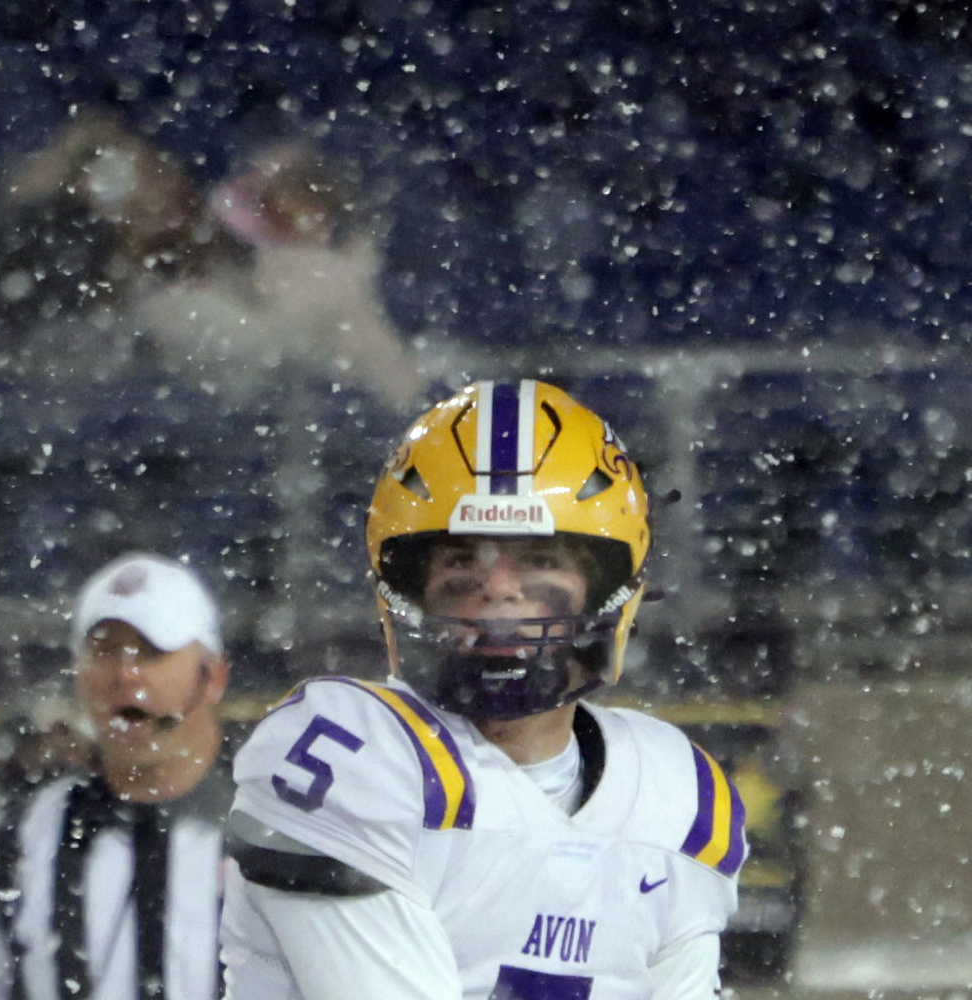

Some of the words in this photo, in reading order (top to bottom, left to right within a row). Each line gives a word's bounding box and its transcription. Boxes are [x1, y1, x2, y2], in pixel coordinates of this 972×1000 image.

[460, 505, 543, 522] Riddell
[272, 714, 364, 813] 5
[521, 913, 596, 963] AVON
